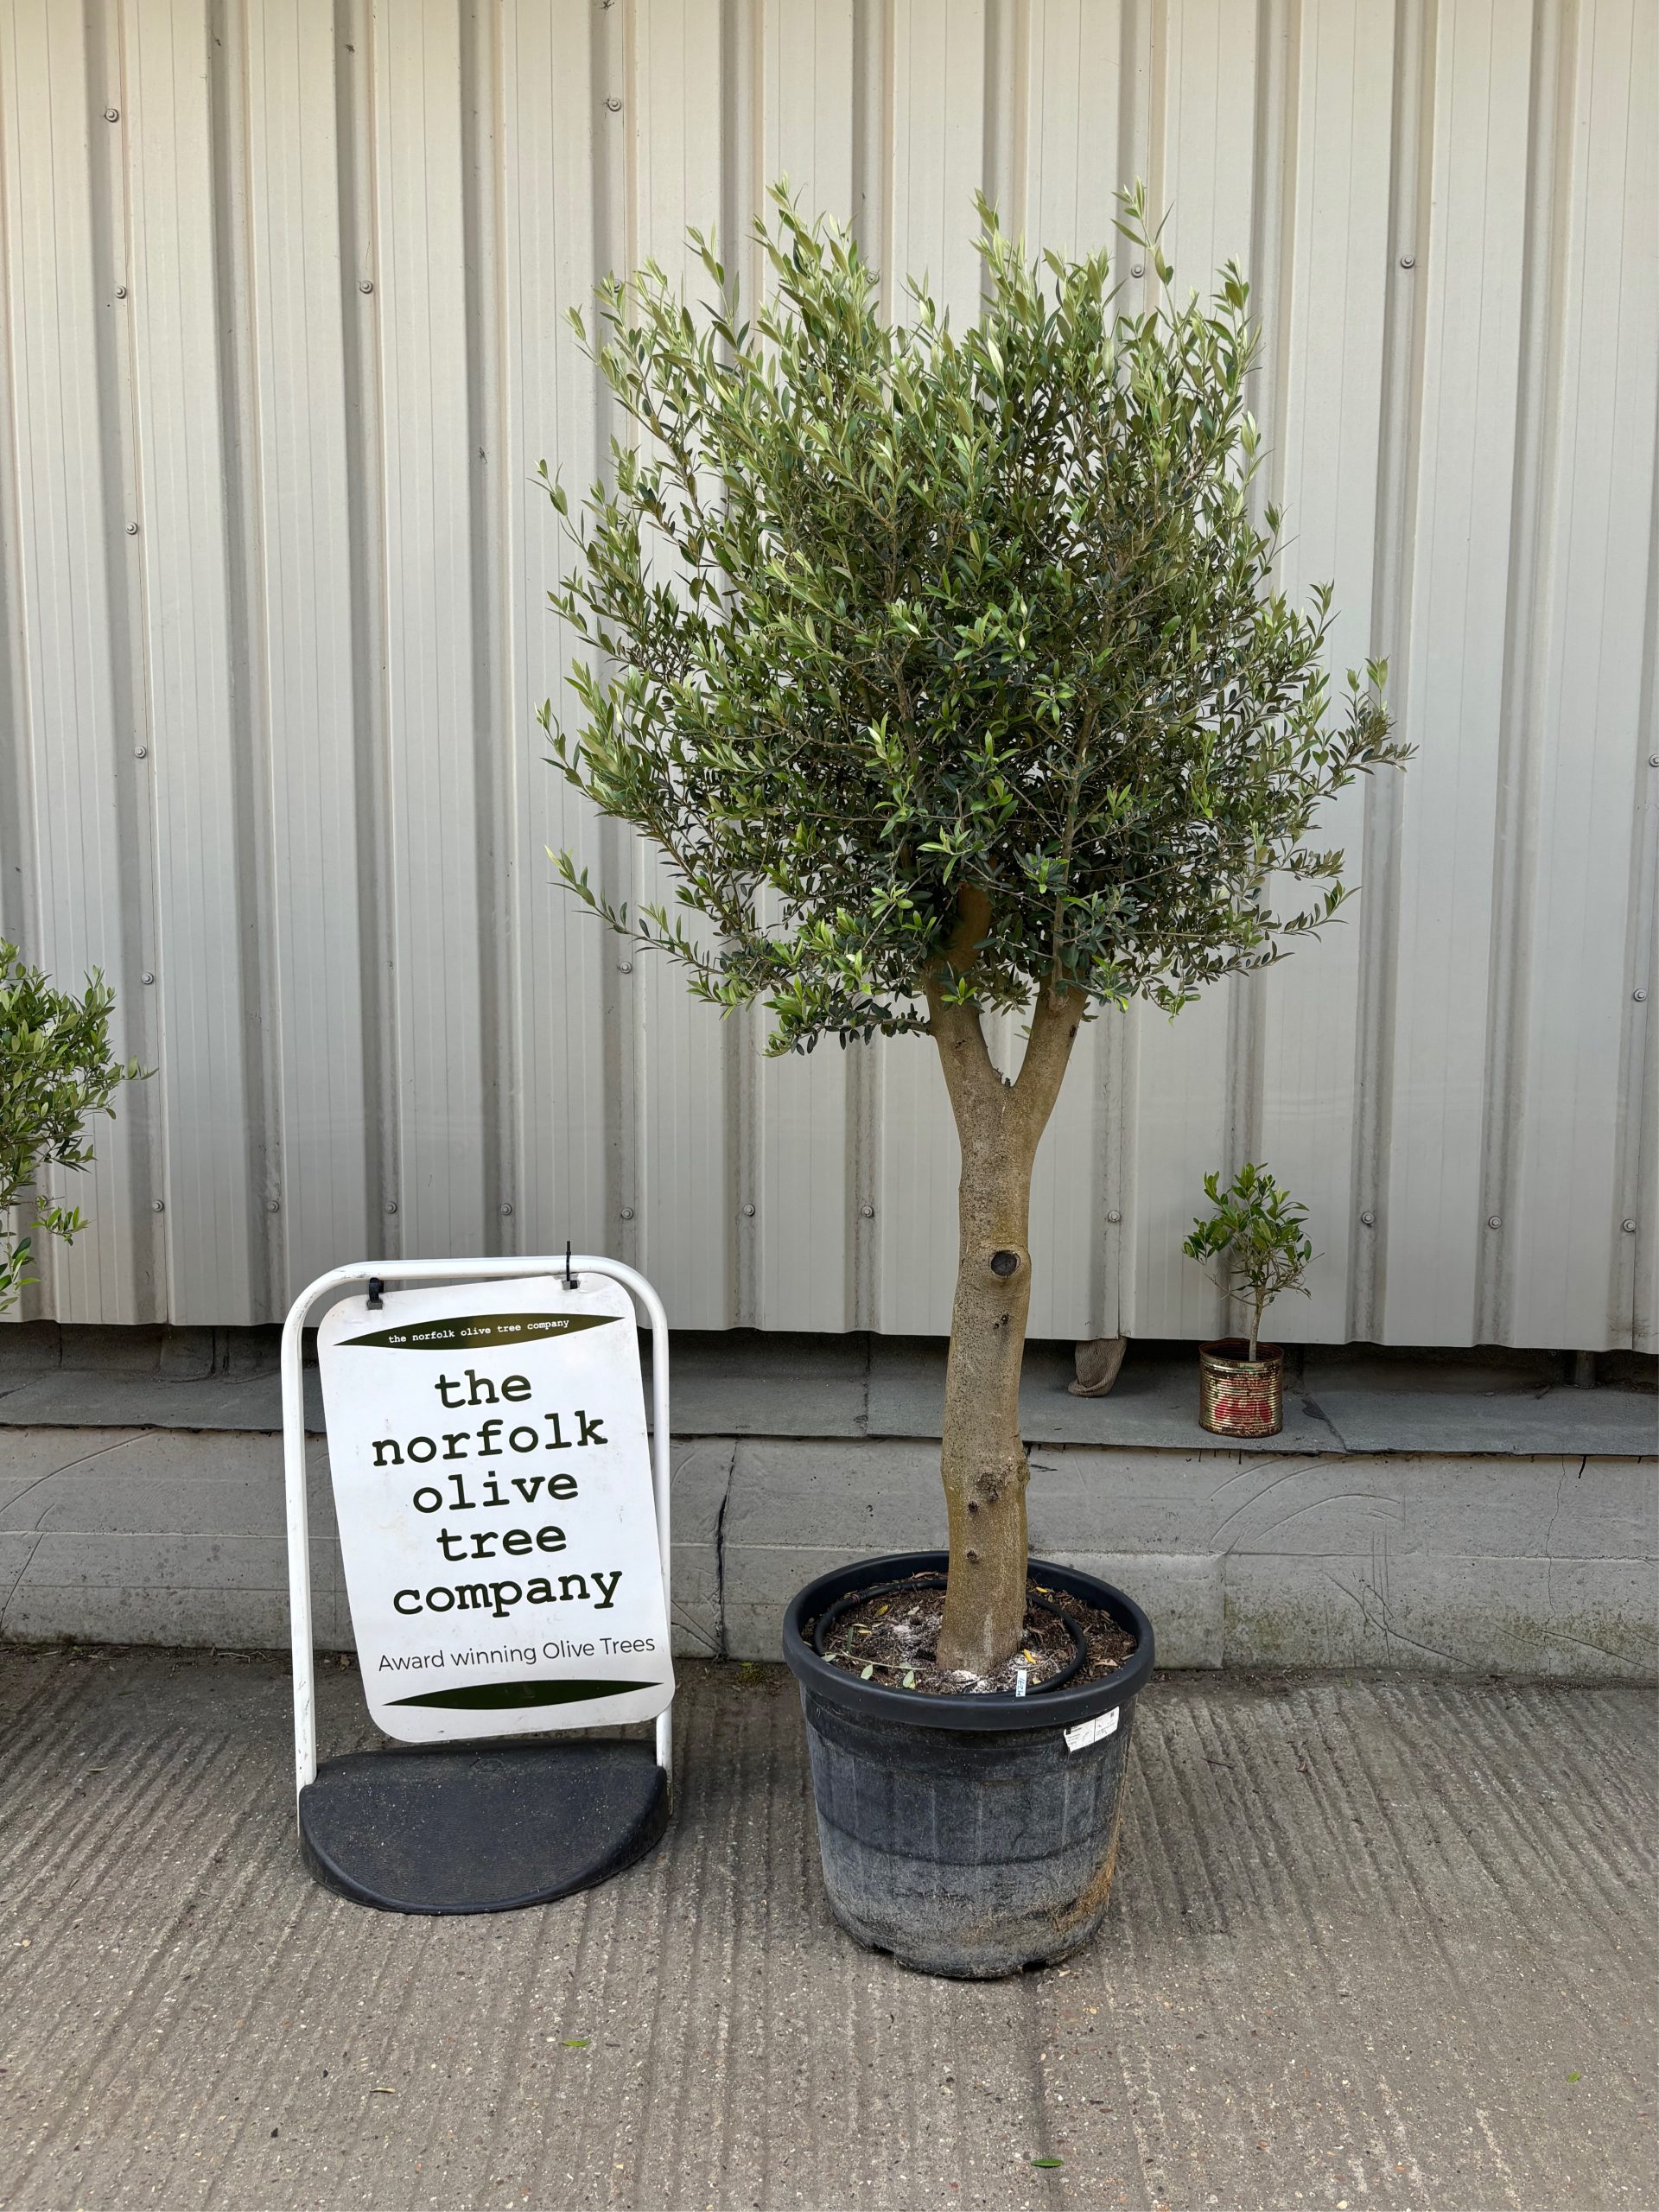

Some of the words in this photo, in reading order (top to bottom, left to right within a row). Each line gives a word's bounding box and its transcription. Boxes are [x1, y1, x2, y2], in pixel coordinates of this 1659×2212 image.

[388, 1334, 407, 1344] the
[412, 1329, 455, 1342] norfolk
[460, 1327, 492, 1337] olive
[497, 1325, 522, 1333] tree
[527, 1319, 569, 1331] company
[435, 1370, 531, 1408] the
[372, 1410, 608, 1466] norfolk
[413, 1471, 578, 1513] olive
[436, 1526, 567, 1561] tree
[394, 1571, 623, 1618] company
[378, 1650, 445, 1671] Award
[450, 1648, 537, 1667] winning
[543, 1640, 595, 1659] Olive
[599, 1638, 656, 1655] Trees
